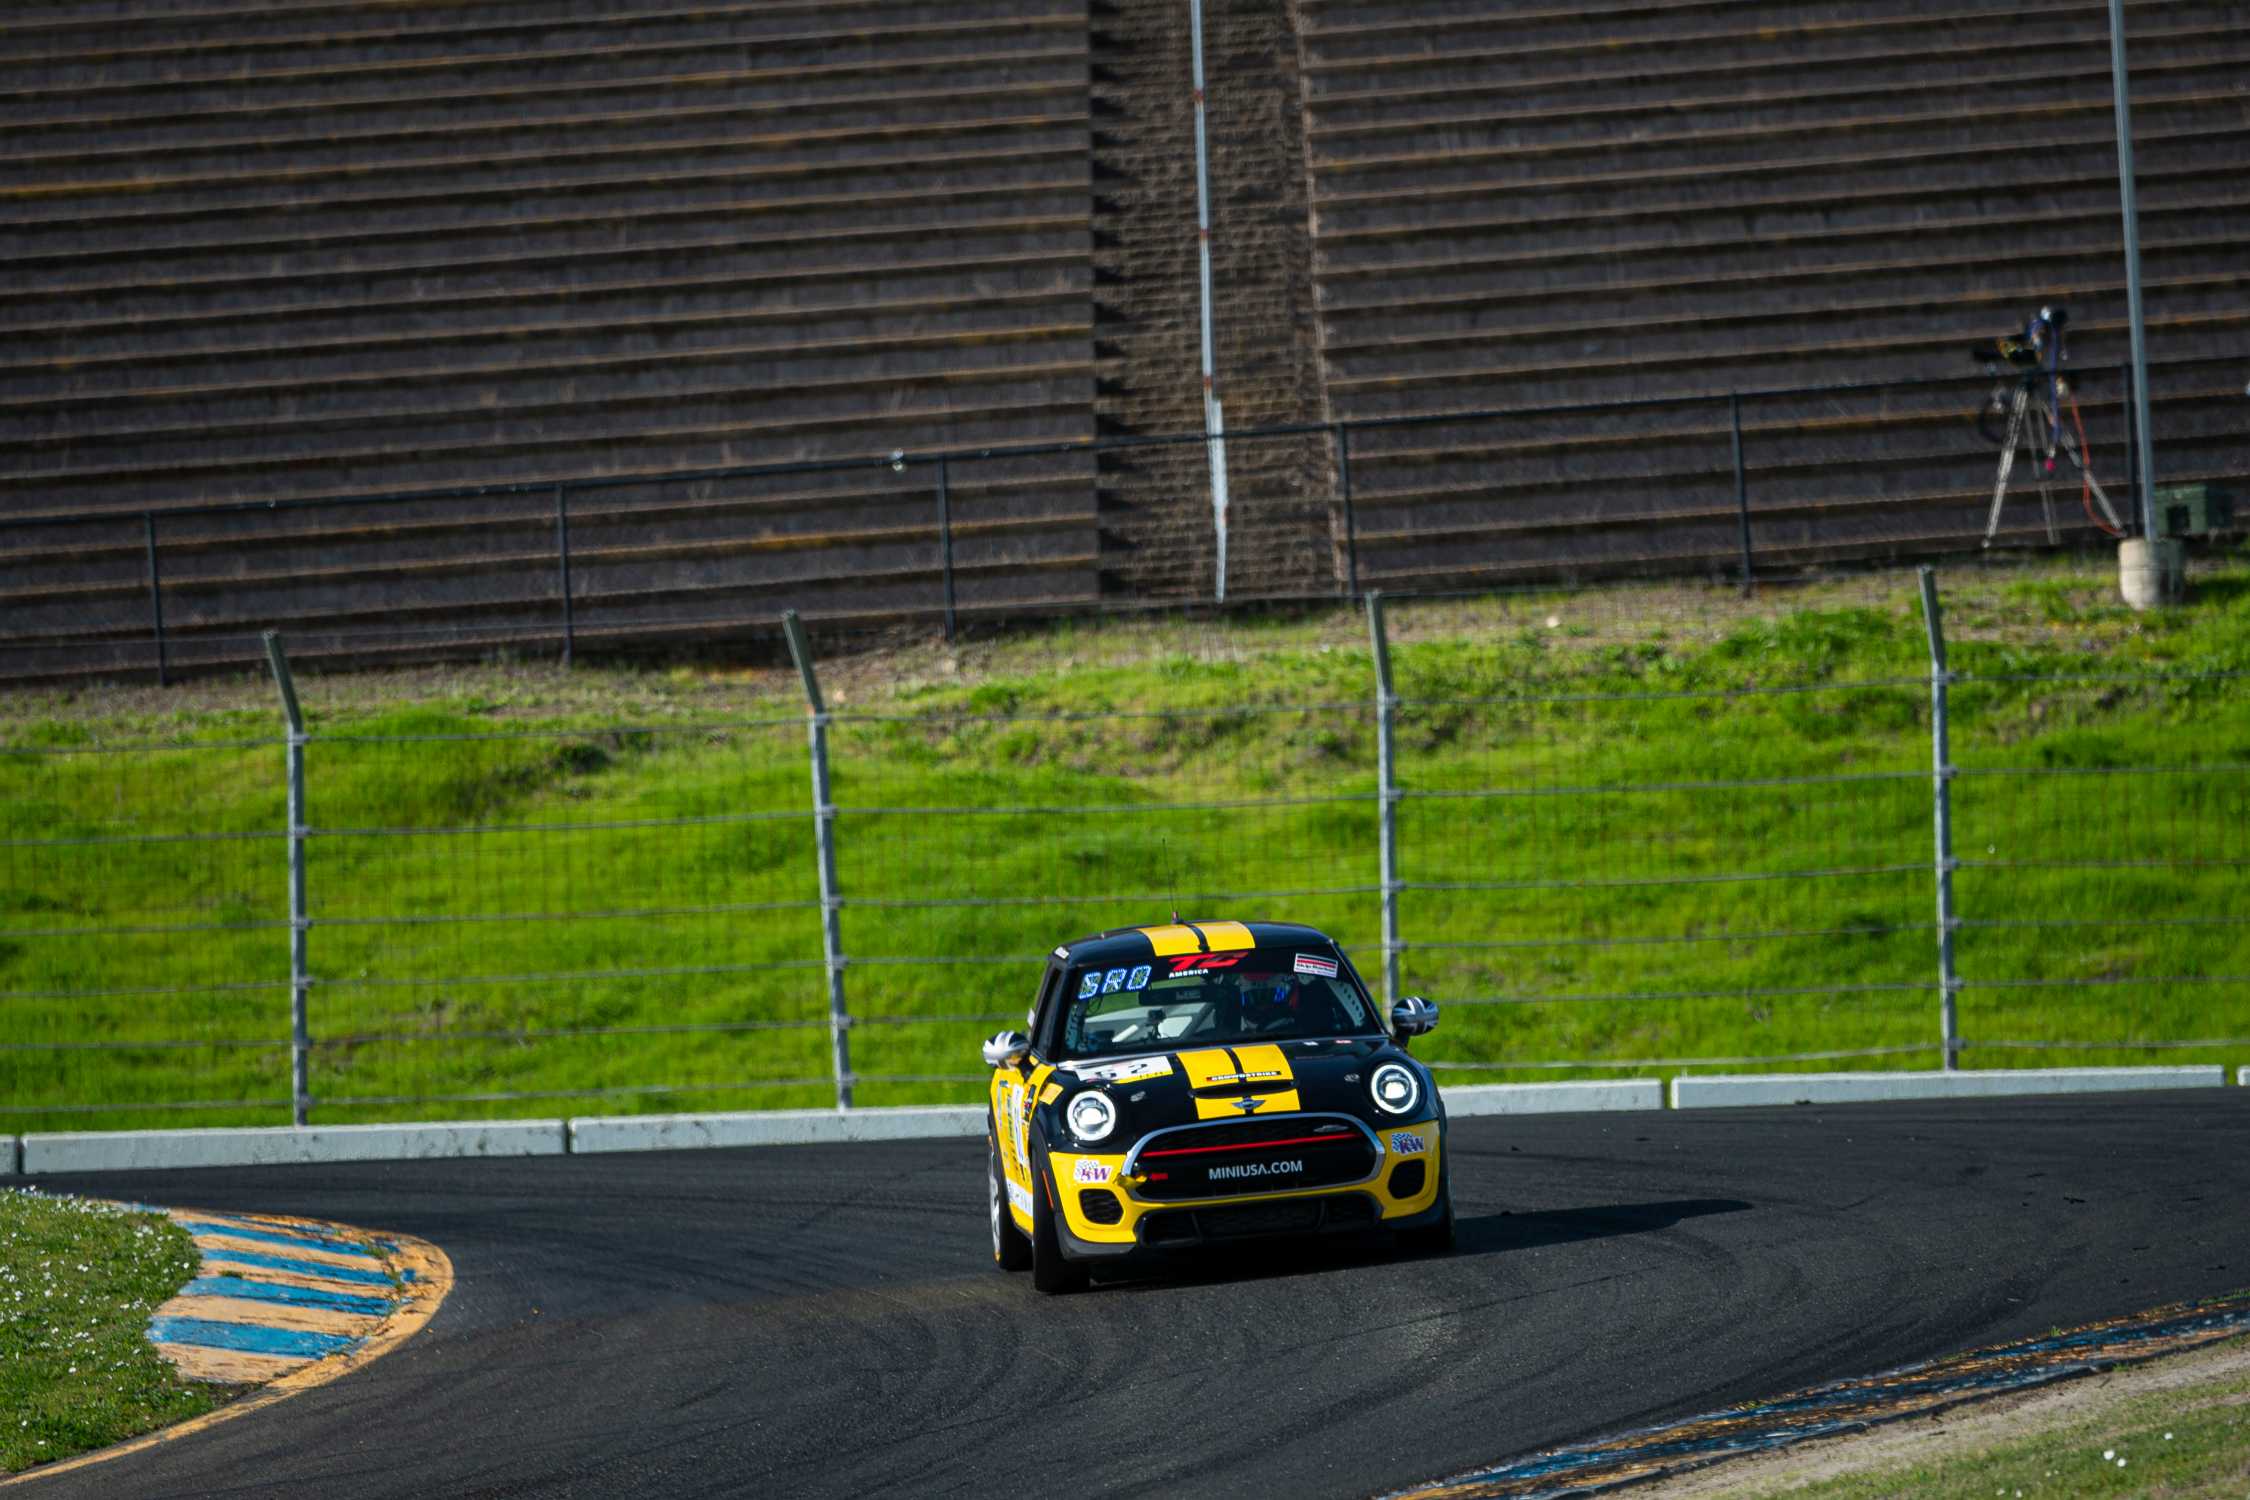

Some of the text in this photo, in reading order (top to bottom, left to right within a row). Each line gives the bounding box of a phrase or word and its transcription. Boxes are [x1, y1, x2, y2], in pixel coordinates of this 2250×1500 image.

[1168, 968, 1209, 978] AMERICA
[1078, 965, 1152, 999] SRO
[1081, 1167, 1110, 1181] KW
[1208, 1160, 1303, 1180] MINIUSA.COM
